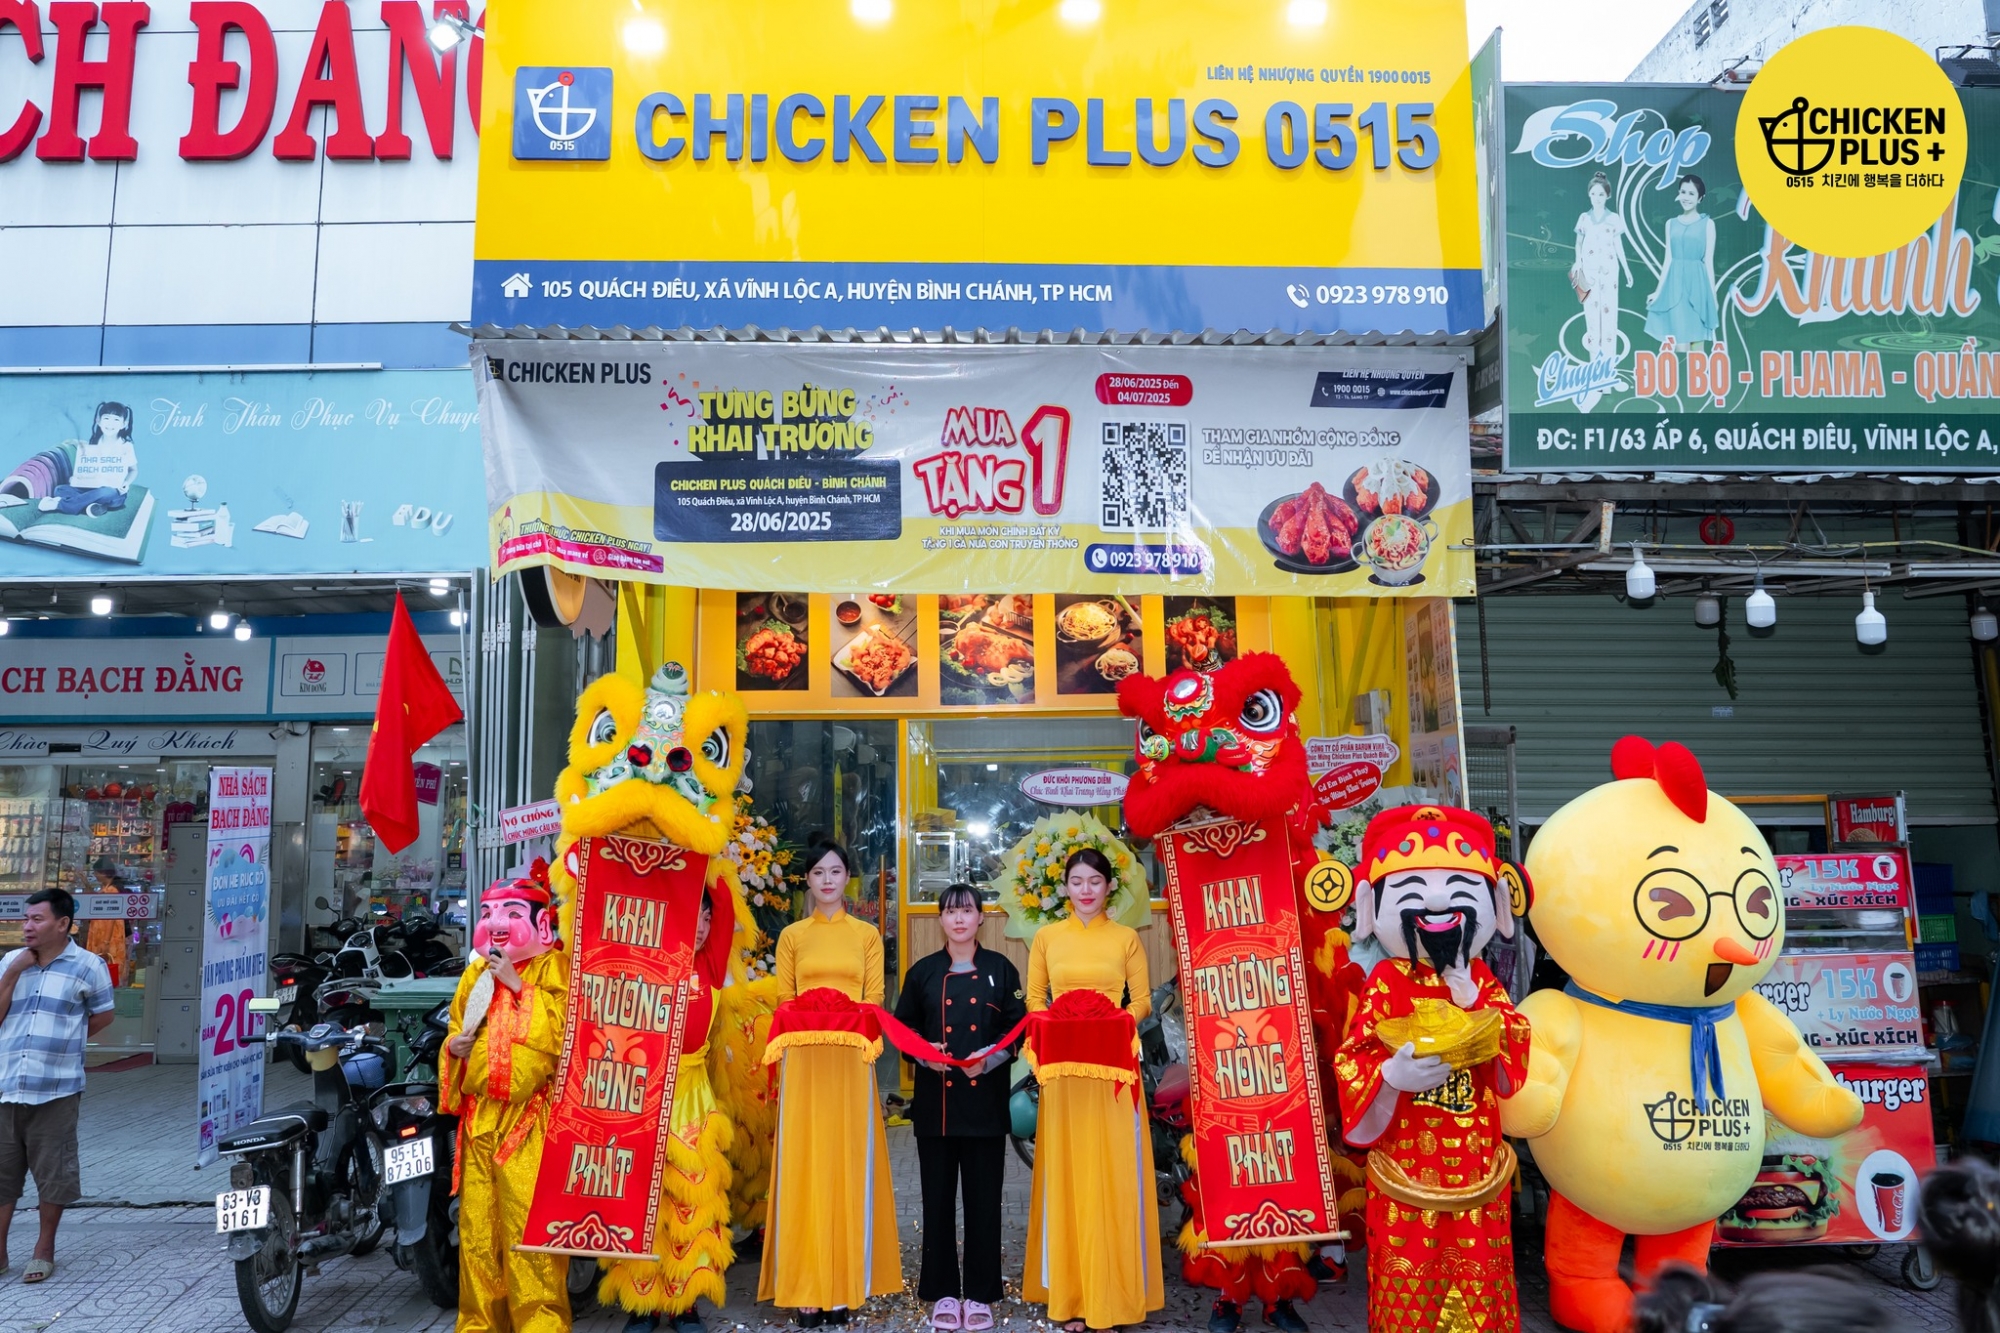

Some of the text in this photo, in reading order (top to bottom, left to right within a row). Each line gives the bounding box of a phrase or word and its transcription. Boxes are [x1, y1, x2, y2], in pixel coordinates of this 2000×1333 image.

[1207, 65, 1431, 86] LIÊN HỆ NHƯỢNG QUYỀN 1900 0015
[635, 92, 1440, 171] CHICKEN PLUS 0515
[549, 140, 575, 152] 0515
[1531, 99, 1711, 190] Shop
[541, 277, 1113, 304] 105 QUÁCH ĐIÊU, XÃ VĨNH LỘC A, HUYỆN BÌNH CHÁNH, TP HCM
[1315, 285, 1449, 305] 0923 978 910
[508, 361, 651, 384] CHICKEN PLUS
[1109, 376, 1180, 390] 28/06/2025 Đến
[1634, 336, 1679, 399] ĐỒ
[1687, 341, 1732, 407] BỘ
[1761, 350, 1886, 398] PIJAMA
[1914, 337, 2000, 403] QUẦN
[698, 382, 857, 419] TƯNG BỪNG
[1117, 391, 1171, 404] 04/07/2025
[1333, 384, 1351, 394] 1900
[1352, 385, 1370, 394] 0015
[150, 397, 205, 435] Tinh
[223, 397, 282, 434] Thần
[290, 397, 354, 431] Phục
[365, 397, 401, 431] Vụ
[688, 420, 875, 453] KHAI TRƯƠNG
[1201, 426, 1402, 450] THAM GIA NHÓM CỘNG ĐỒNG
[1537, 418, 1999, 457] ĐC: F1/63 ẤP 6, QUÁCH ĐIÊU, VĨNH LỘC A,
[941, 404, 1072, 517] MUA 1
[1202, 444, 1314, 471] ĐỂ NHẬN ƯU ĐÃI
[670, 475, 887, 491] CHICKEN PLUS QUÁCH ĐIÊU BÌNH CHÁNH
[913, 451, 1027, 521] TẶNG
[677, 497, 691, 506] 105
[691, 496, 716, 507] Quách
[736, 496, 745, 506] xã
[745, 496, 763, 506] Vĩnh
[764, 495, 777, 508] Lộc
[785, 494, 809, 508] huyện
[809, 495, 826, 505] Bình
[853, 494, 862, 504] TP
[862, 494, 881, 504] HCM
[730, 511, 832, 532] 28/06/2025
[940, 525, 955, 536] KHI
[956, 525, 977, 536] MUA
[978, 524, 999, 536] MÓN
[1001, 524, 1028, 536] CHÍNH
[1030, 523, 1047, 536] BẤT
[570, 529, 607, 546] CHICKEN
[607, 535, 627, 549] PLUS
[954, 537, 967, 549] GÀ
[988, 539, 1010, 549] CON
[1010, 537, 1045, 549] TRUYỀN
[1046, 537, 1079, 549] THỐNG
[1110, 552, 1142, 568] 0923
[1145, 553, 1171, 568] 978
[1, 652, 244, 700] CH BẠCH ĐẰNG
[0, 729, 239, 754] Chào Quý Khách
[217, 769, 268, 797] NHÀ SÁCH
[1043, 774, 1056, 785] ĐỨC
[1071, 775, 1096, 785] PHƯƠNG
[211, 797, 270, 836] BẠCH ĐẰNG
[505, 815, 518, 829] VỢ
[521, 807, 554, 824] CHỒNG
[1850, 803, 1896, 827] Hamburg
[1805, 859, 1860, 879] 15K
[1830, 880, 1864, 892] Nước
[1866, 880, 1900, 894] Ngọt
[1201, 875, 1266, 932] KHAI
[1815, 893, 1849, 906] XÚC
[1853, 893, 1897, 906] XÍCH
[602, 893, 667, 949] KHAI
[1194, 953, 1292, 1019] TRƯƠNG
[1822, 968, 1878, 1000] 15K
[581, 971, 673, 1034] TRƯƠNG
[1829, 1005, 1920, 1023] Ly Nước Ngọt
[1836, 1027, 1918, 1046] XÚC XÍCH
[1214, 1028, 1288, 1100] HỒNG
[582, 1040, 648, 1115] HỒNG
[1699, 1119, 1741, 1138] PLUS
[233, 1136, 266, 1146] HONDA
[391, 1141, 426, 1164] 95-E1
[1663, 1143, 1682, 1151] 0515
[1226, 1120, 1295, 1187] PHÁT
[387, 1156, 432, 1183] 873.06
[563, 1133, 635, 1199] PHÁT
[222, 1209, 259, 1230] 9161
